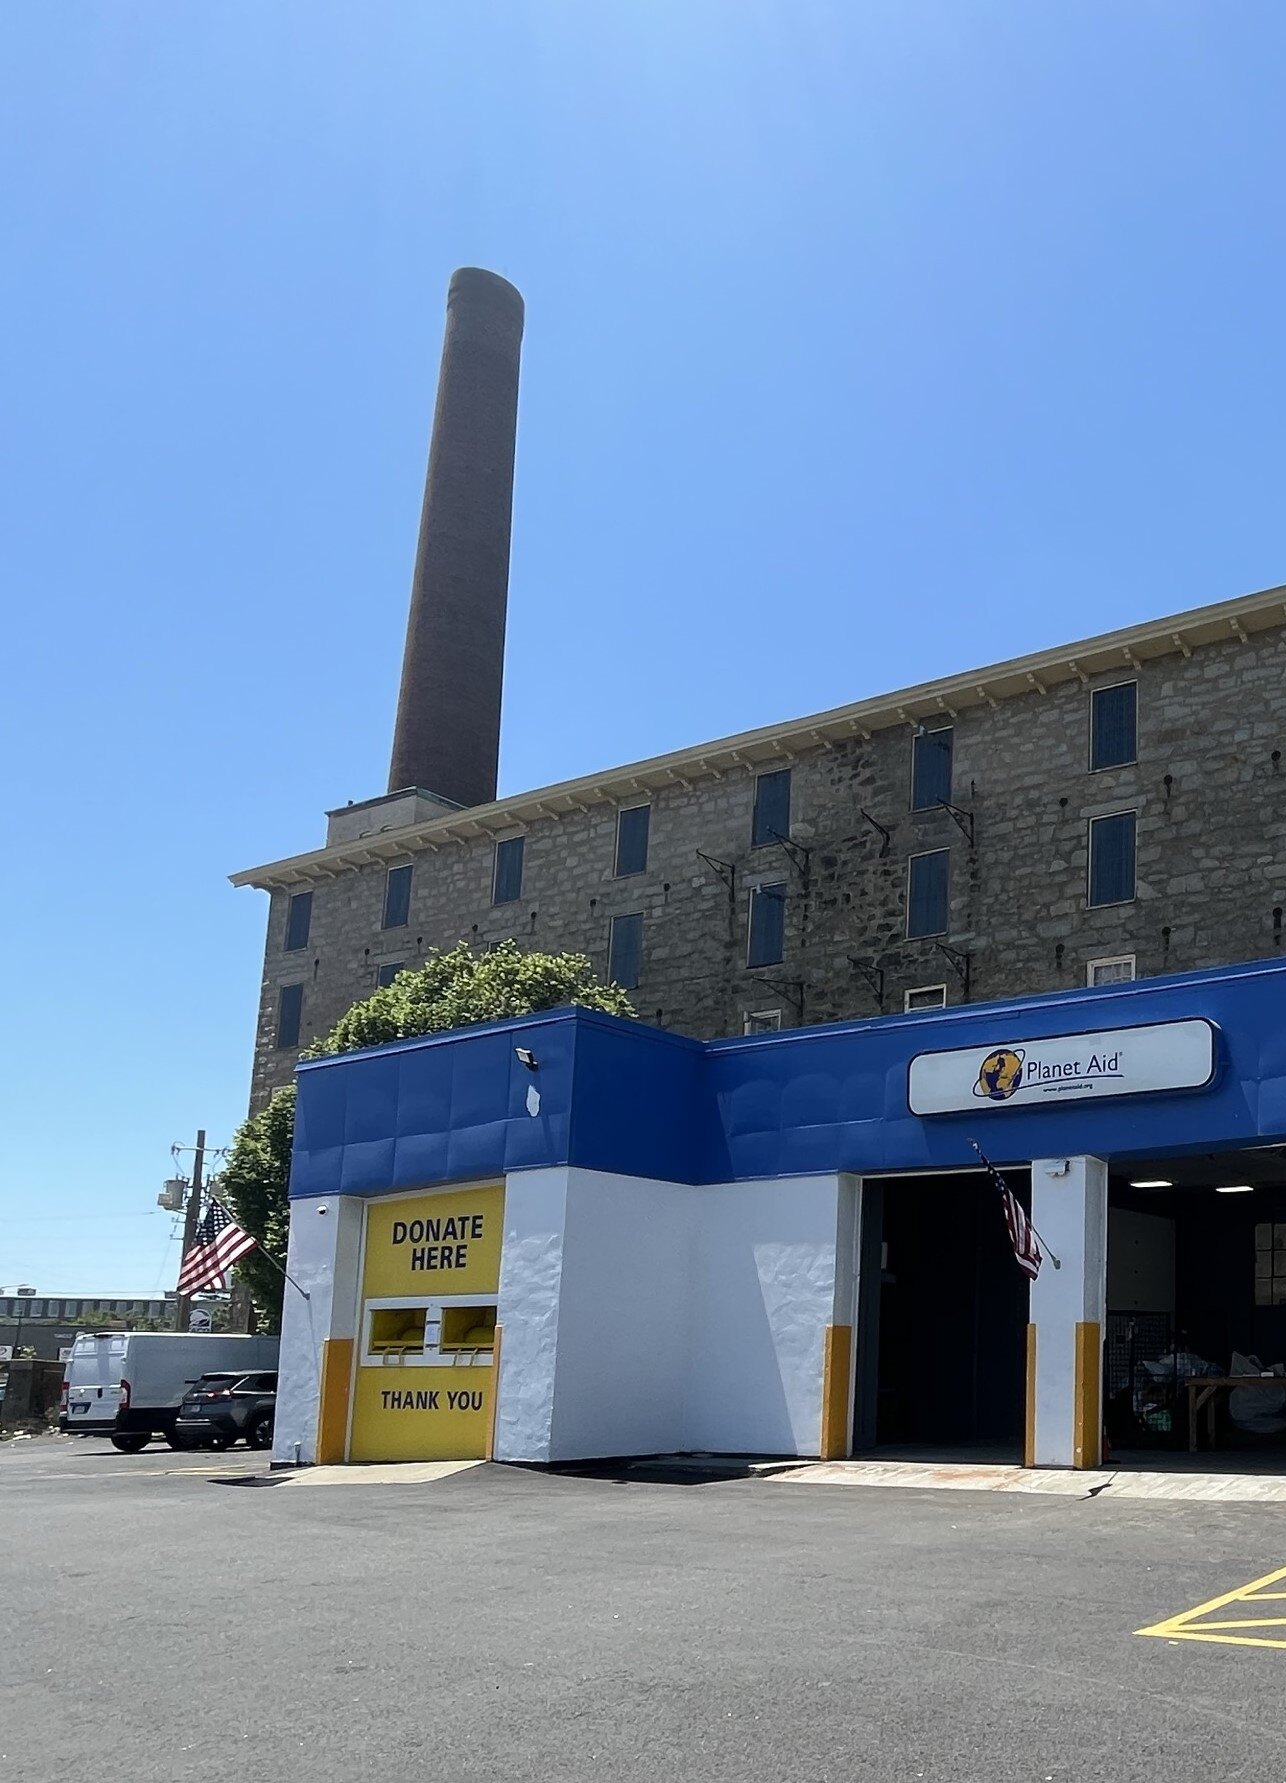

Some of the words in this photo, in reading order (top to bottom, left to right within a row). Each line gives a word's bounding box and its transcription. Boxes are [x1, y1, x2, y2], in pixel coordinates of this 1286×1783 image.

[1027, 1060, 1081, 1080] Planet
[1087, 1052, 1119, 1074] Aid
[392, 1215, 484, 1245] DONATE
[411, 1244, 468, 1271] HERE
[381, 1390, 440, 1410] THANK
[446, 1391, 483, 1411] YOU
